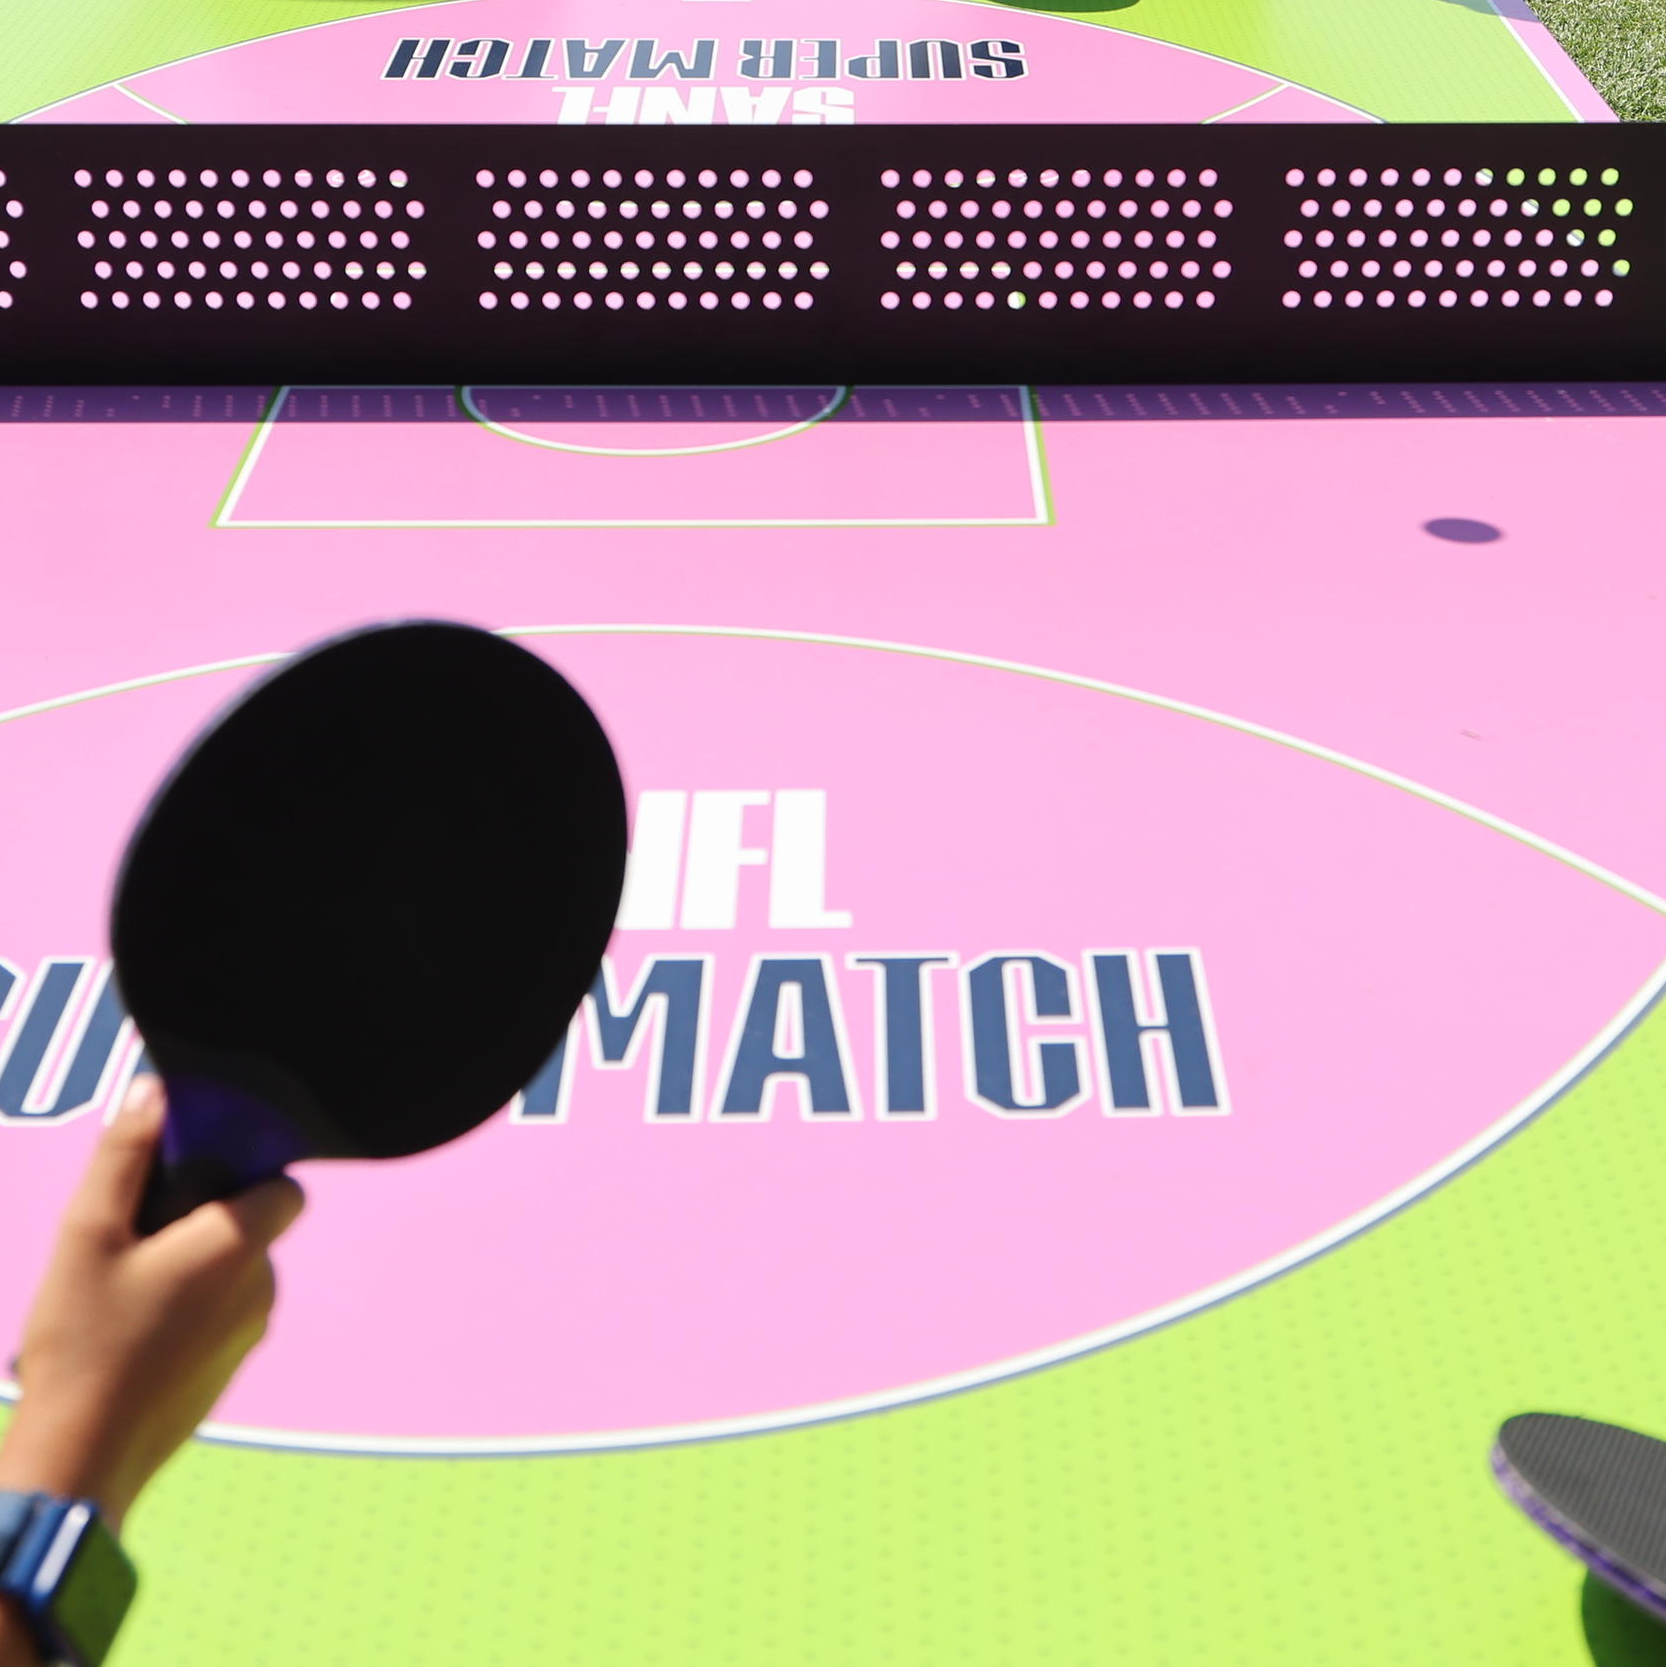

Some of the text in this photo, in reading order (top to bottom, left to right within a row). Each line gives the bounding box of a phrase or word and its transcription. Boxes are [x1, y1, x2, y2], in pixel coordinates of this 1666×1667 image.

[379, 37, 1031, 82] SUPER MATCH
[511, 946, 1231, 1125] MATCH
